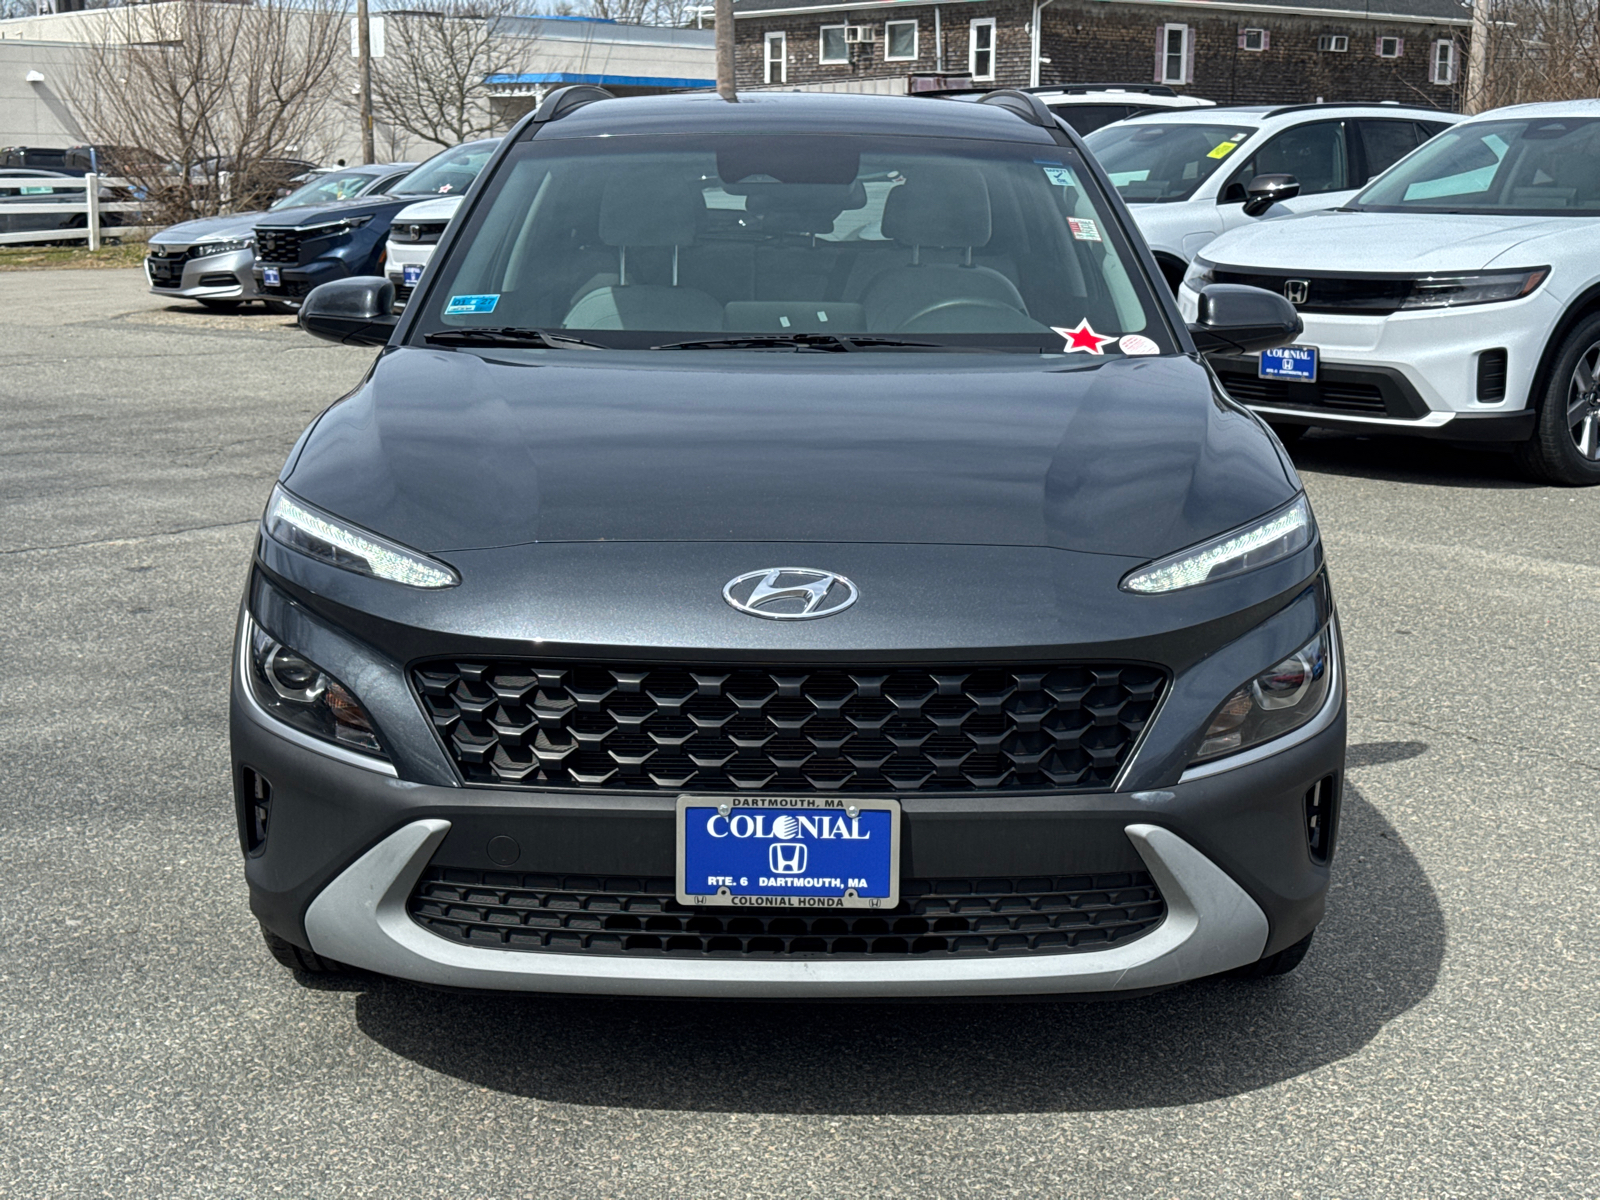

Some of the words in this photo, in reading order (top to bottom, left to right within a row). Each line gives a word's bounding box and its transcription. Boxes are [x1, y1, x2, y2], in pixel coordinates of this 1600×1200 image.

[1266, 348, 1311, 360] COLONIAL
[732, 798, 820, 808] DARTMOUTH,
[824, 800, 845, 808] MA
[706, 814, 871, 840] COLONIAL
[707, 876, 737, 886] RTE.
[739, 877, 749, 887] 6
[758, 877, 845, 889] DARTMOUTH,
[847, 879, 868, 888] MA
[731, 896, 795, 907] COLONIAL
[798, 897, 844, 907] HONDA
